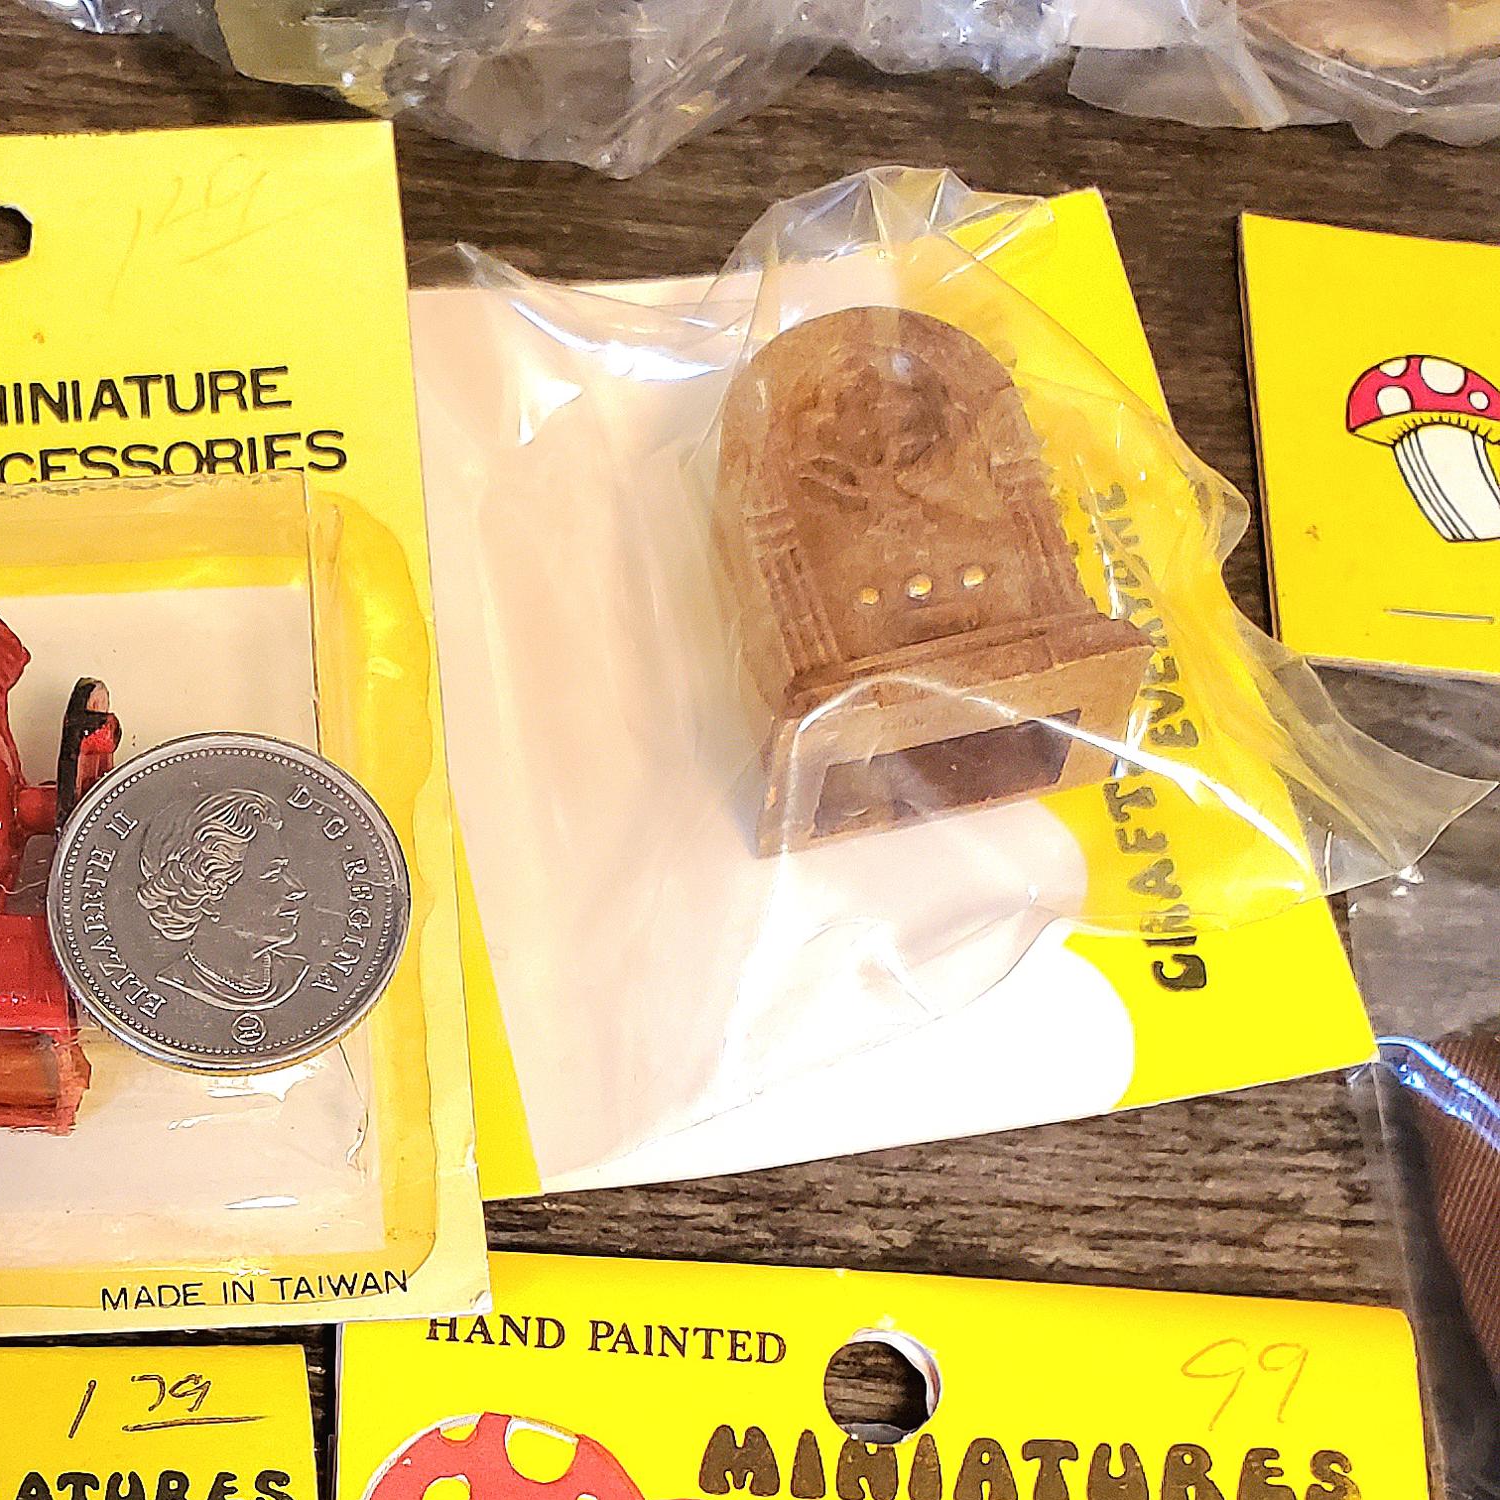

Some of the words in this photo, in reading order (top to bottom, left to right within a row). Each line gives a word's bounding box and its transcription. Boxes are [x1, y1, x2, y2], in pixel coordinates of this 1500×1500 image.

[105, 808, 140, 842] II
[80, 840, 168, 1019] ELIZABETH
[101, 1282, 207, 1312] MADE
[222, 1279, 255, 1305] IN
[269, 1269, 409, 1301] TAIWAN
[426, 1314, 566, 1350] HAND
[587, 1319, 788, 1365] PAINTED
